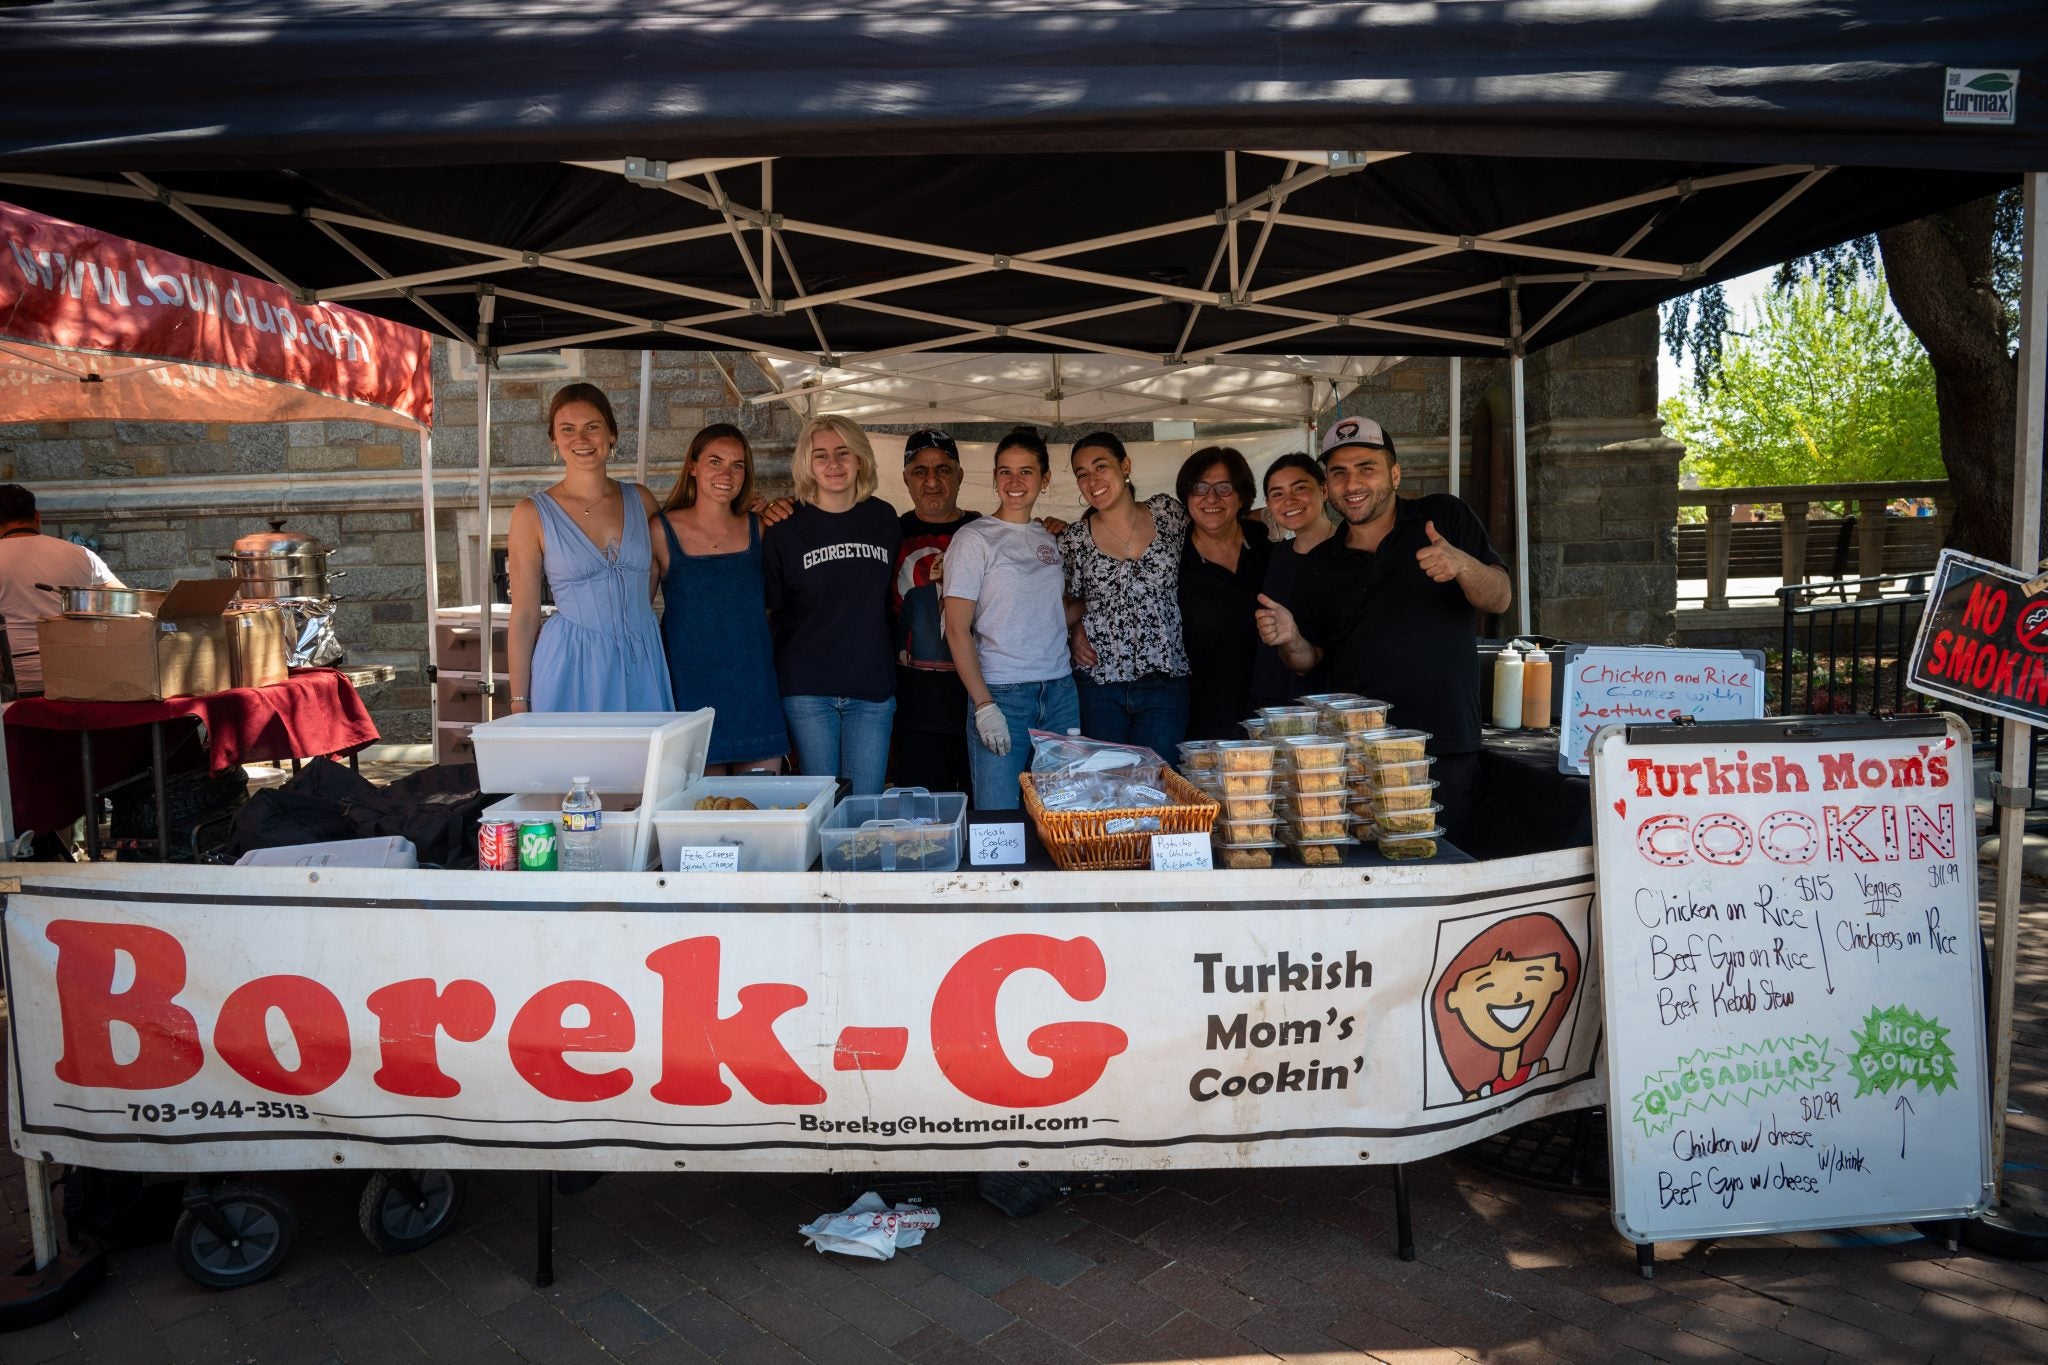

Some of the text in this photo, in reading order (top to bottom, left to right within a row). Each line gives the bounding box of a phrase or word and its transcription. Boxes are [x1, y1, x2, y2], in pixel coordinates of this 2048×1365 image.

[1946, 89, 2009, 113] Eurmax
[803, 542, 889, 570] GEORGETOWN
[1961, 581, 2009, 636] NO
[1580, 664, 1752, 688] Chicken and Rice
[1686, 687, 1743, 705] with
[1578, 703, 1682, 720] Lettuce
[1627, 745, 1950, 798] Turkish Mom's
[978, 846, 999, 860] $6
[1636, 803, 1956, 868] COOKIN
[1635, 883, 1809, 929] Chicken on Rice
[1794, 874, 1834, 901] $15
[1853, 863, 1960, 917] Veggies $11.99
[1907, 931, 1921, 946] on
[1925, 906, 1959, 955] Rice
[1193, 949, 1373, 994] Turkish
[1650, 933, 1817, 987] Beef Gyro on Rice
[45, 918, 1129, 1108] Borek-G
[1657, 983, 1700, 1026] Beef
[1759, 979, 1795, 1011] Stew
[1205, 1006, 1356, 1050] Mom's
[1189, 1055, 1364, 1102] Cookin'
[1859, 1053, 1945, 1077] BOWLS
[127, 1099, 310, 1123] 703-944-3513
[799, 1113, 1089, 1137] Borekg@hotmail.com
[1799, 1091, 1841, 1122] $12.99
[1673, 1127, 1738, 1161] Chicken
[1767, 1113, 1814, 1148] cheese
[1658, 1171, 1702, 1209] Beef
[1707, 1166, 1743, 1209] Gyro
[1773, 1162, 1819, 1194] cheese
